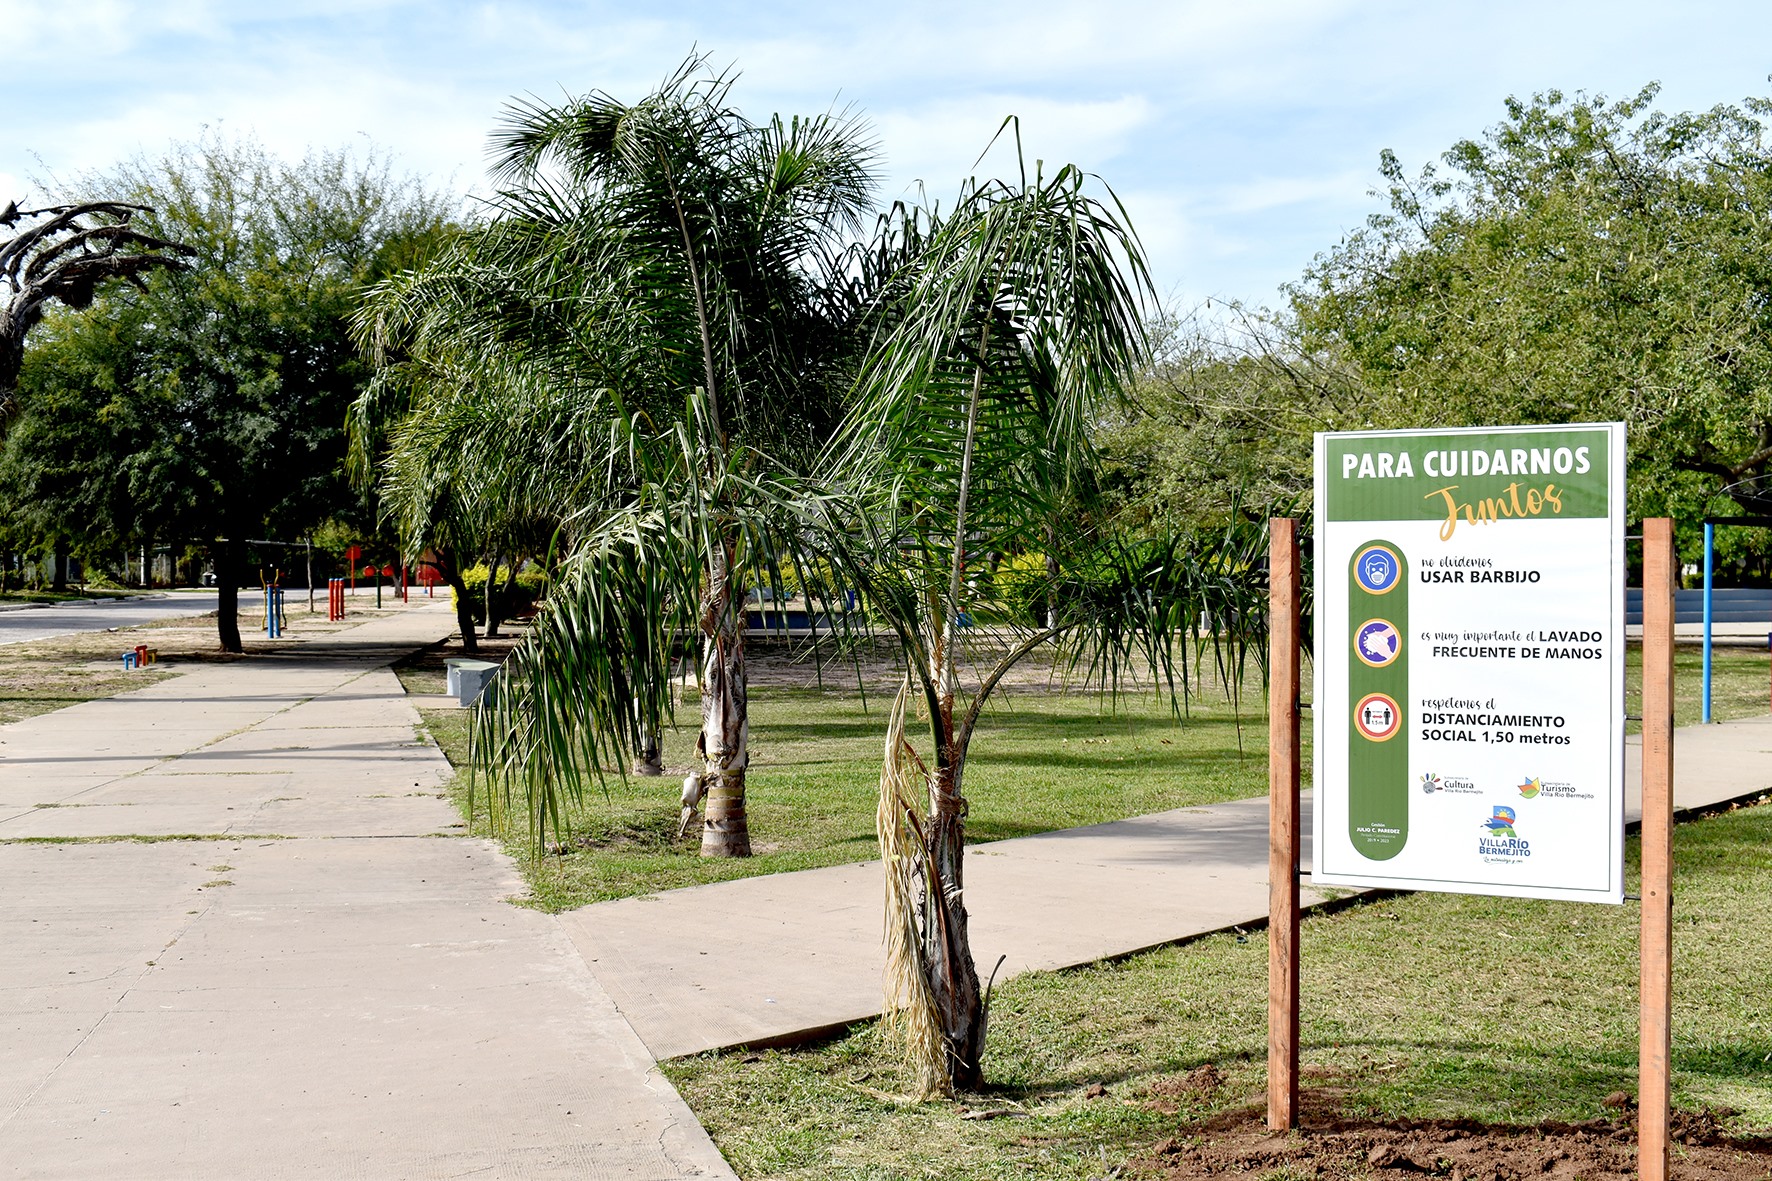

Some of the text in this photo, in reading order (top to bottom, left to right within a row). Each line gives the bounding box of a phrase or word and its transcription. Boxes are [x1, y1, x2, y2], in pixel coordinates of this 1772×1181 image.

[1342, 446, 1591, 479] PARA CUIDARNOS
[1424, 482, 1564, 542] Juntos
[1421, 556, 1493, 568] no olvidemos
[1421, 570, 1541, 583] USAR BARBIJO
[1421, 630, 1603, 645] es muy importante el LAVADO
[1432, 646, 1603, 660] FRECUENTE DE MANOS
[1422, 697, 1496, 711] respetemos el
[1422, 713, 1565, 728] DISTANCIAMIENTO
[1422, 729, 1571, 745] SOCIAL 1,50 metros
[1444, 780, 1474, 789] Cultura
[1541, 784, 1576, 793] Turismo
[1479, 845, 1531, 857] BERMEJITO
